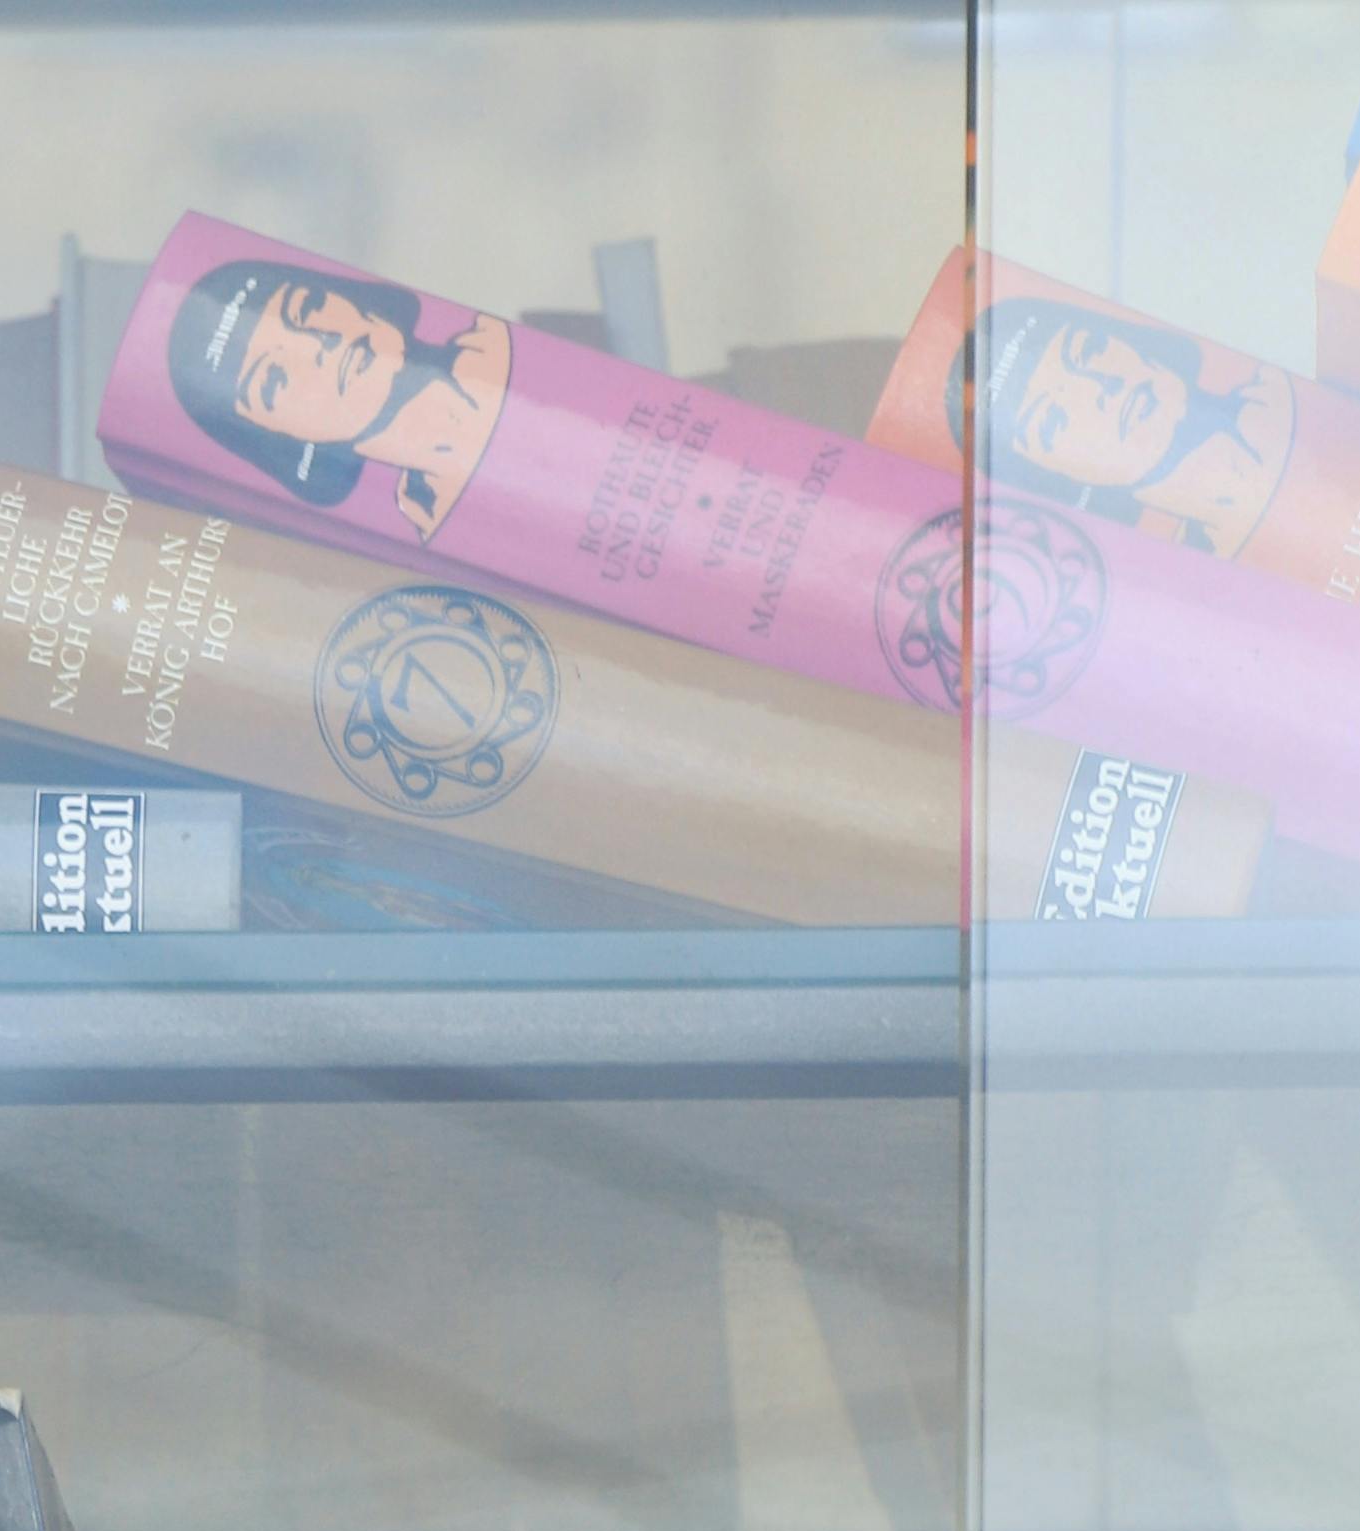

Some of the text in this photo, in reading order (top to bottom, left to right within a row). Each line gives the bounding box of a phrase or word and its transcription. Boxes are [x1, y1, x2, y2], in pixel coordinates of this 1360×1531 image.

[29, 506, 92, 668] RÜCKKEHR
[146, 516, 232, 751] KÖNIG ARTHURS
